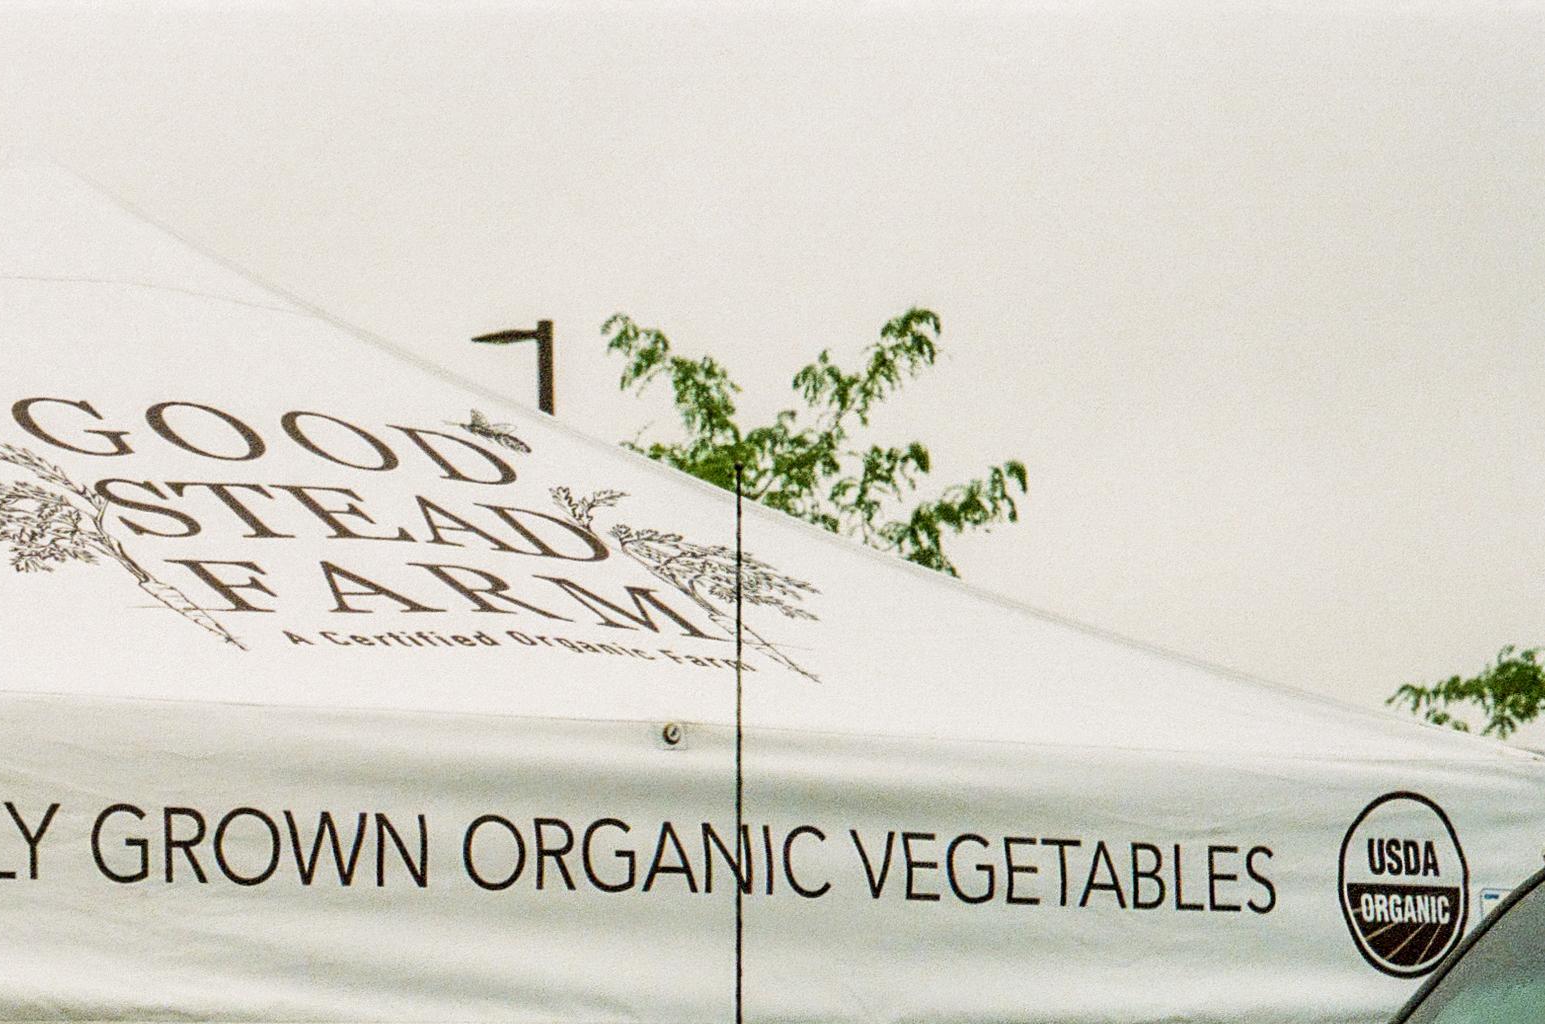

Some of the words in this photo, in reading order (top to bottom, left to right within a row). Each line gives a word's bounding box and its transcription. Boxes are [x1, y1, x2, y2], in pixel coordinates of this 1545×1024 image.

[11, 396, 517, 486] GOOD
[94, 477, 610, 564] STEAD
[164, 558, 730, 641] FARM
[282, 630, 315, 646] A
[319, 630, 499, 649] Certified
[506, 629, 656, 661] Organic
[659, 648, 758, 673] Farm
[91, 803, 429, 888] GROWN
[462, 814, 833, 900] ORGANIC
[850, 828, 1278, 914] VEGETABLES
[1366, 837, 1441, 878] USDA
[1360, 892, 1451, 925] ORGANIC
